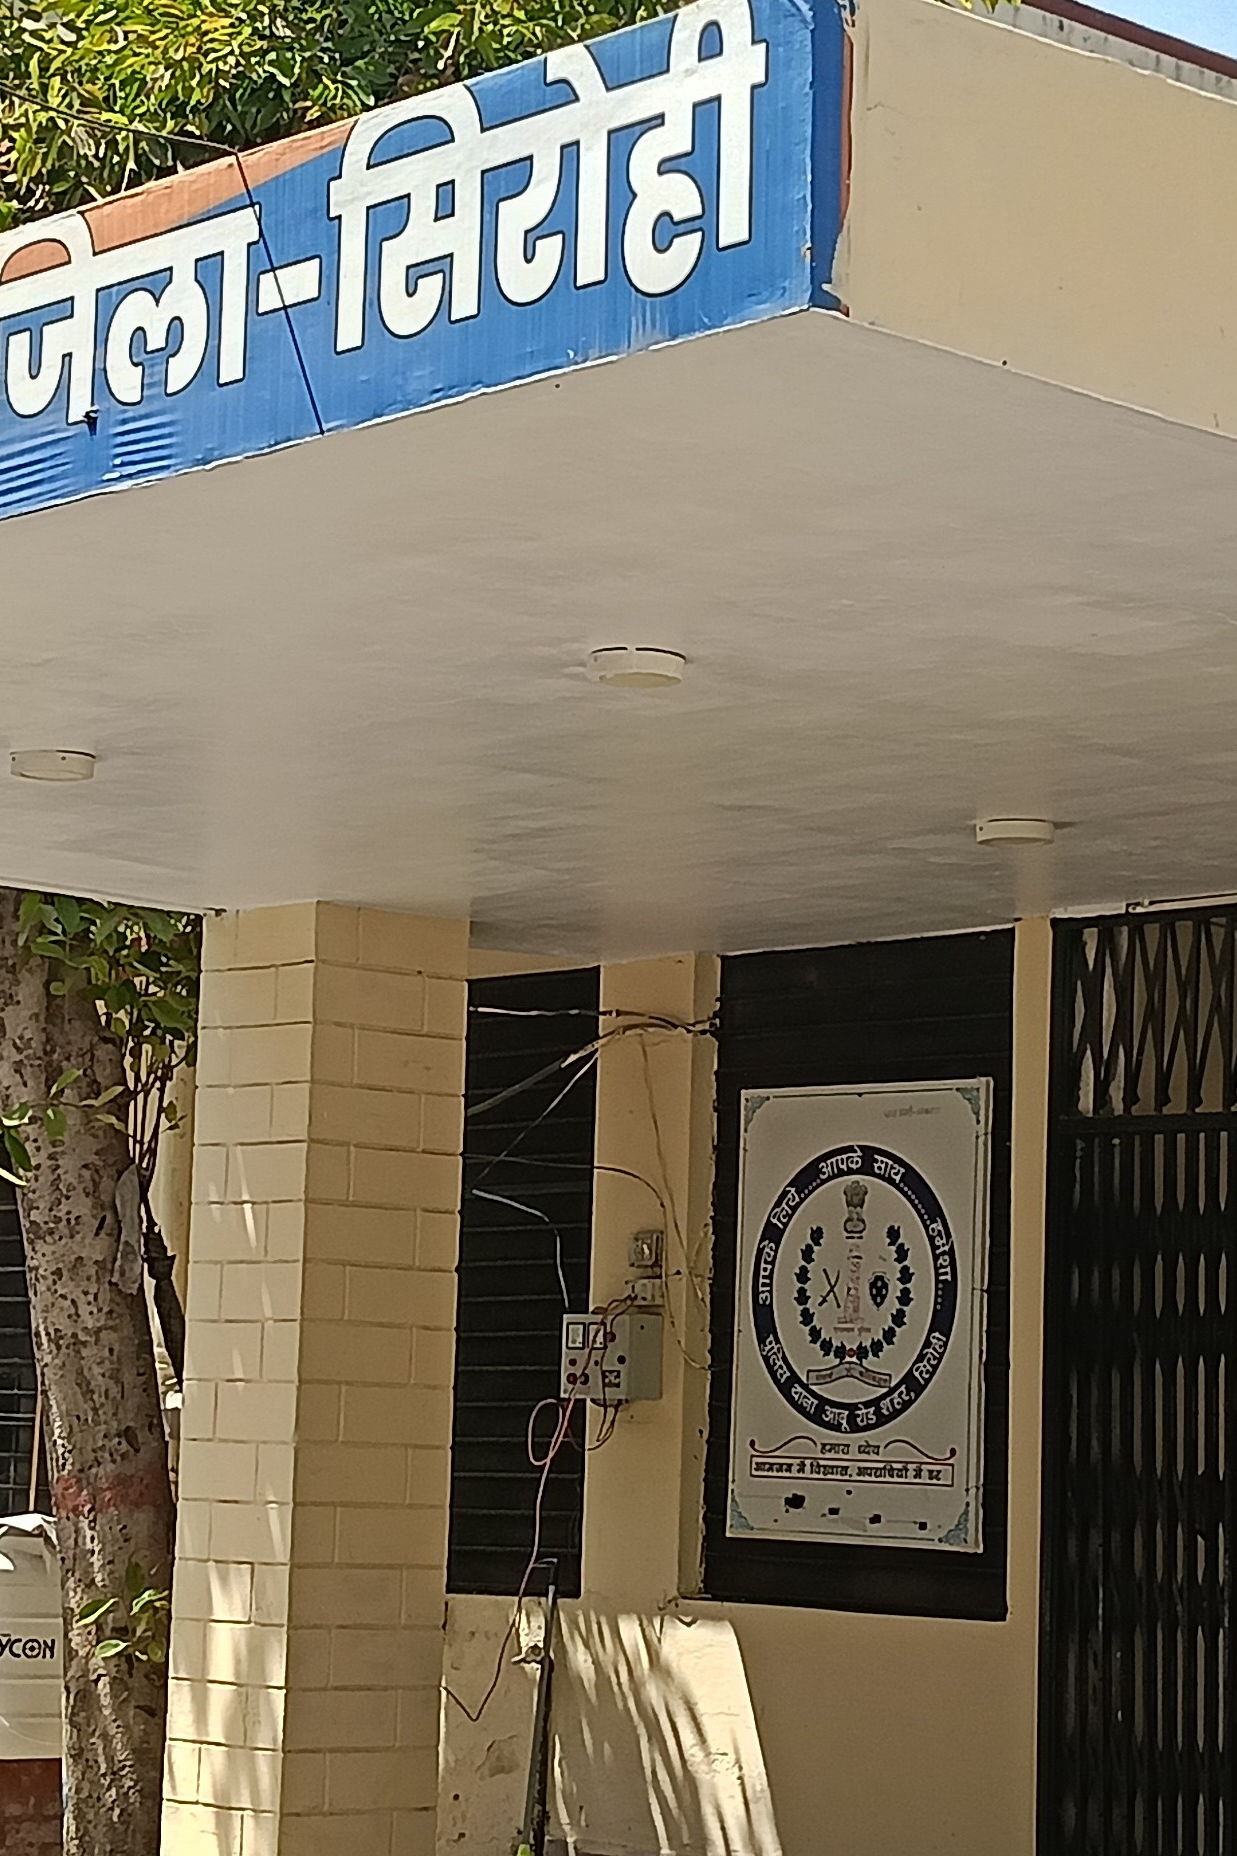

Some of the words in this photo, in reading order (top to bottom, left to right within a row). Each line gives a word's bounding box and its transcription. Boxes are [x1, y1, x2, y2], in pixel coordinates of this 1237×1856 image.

[759, 1239, 776, 1305] आपके
[819, 1145, 863, 1180] आपके
[761, 1333, 791, 1384] पुलिस
[791, 1383, 819, 1415] थाना
[912, 1331, 947, 1385] सिरोही
[820, 1442, 851, 1455] हमारा
[927, 1469, 943, 1482] डर
